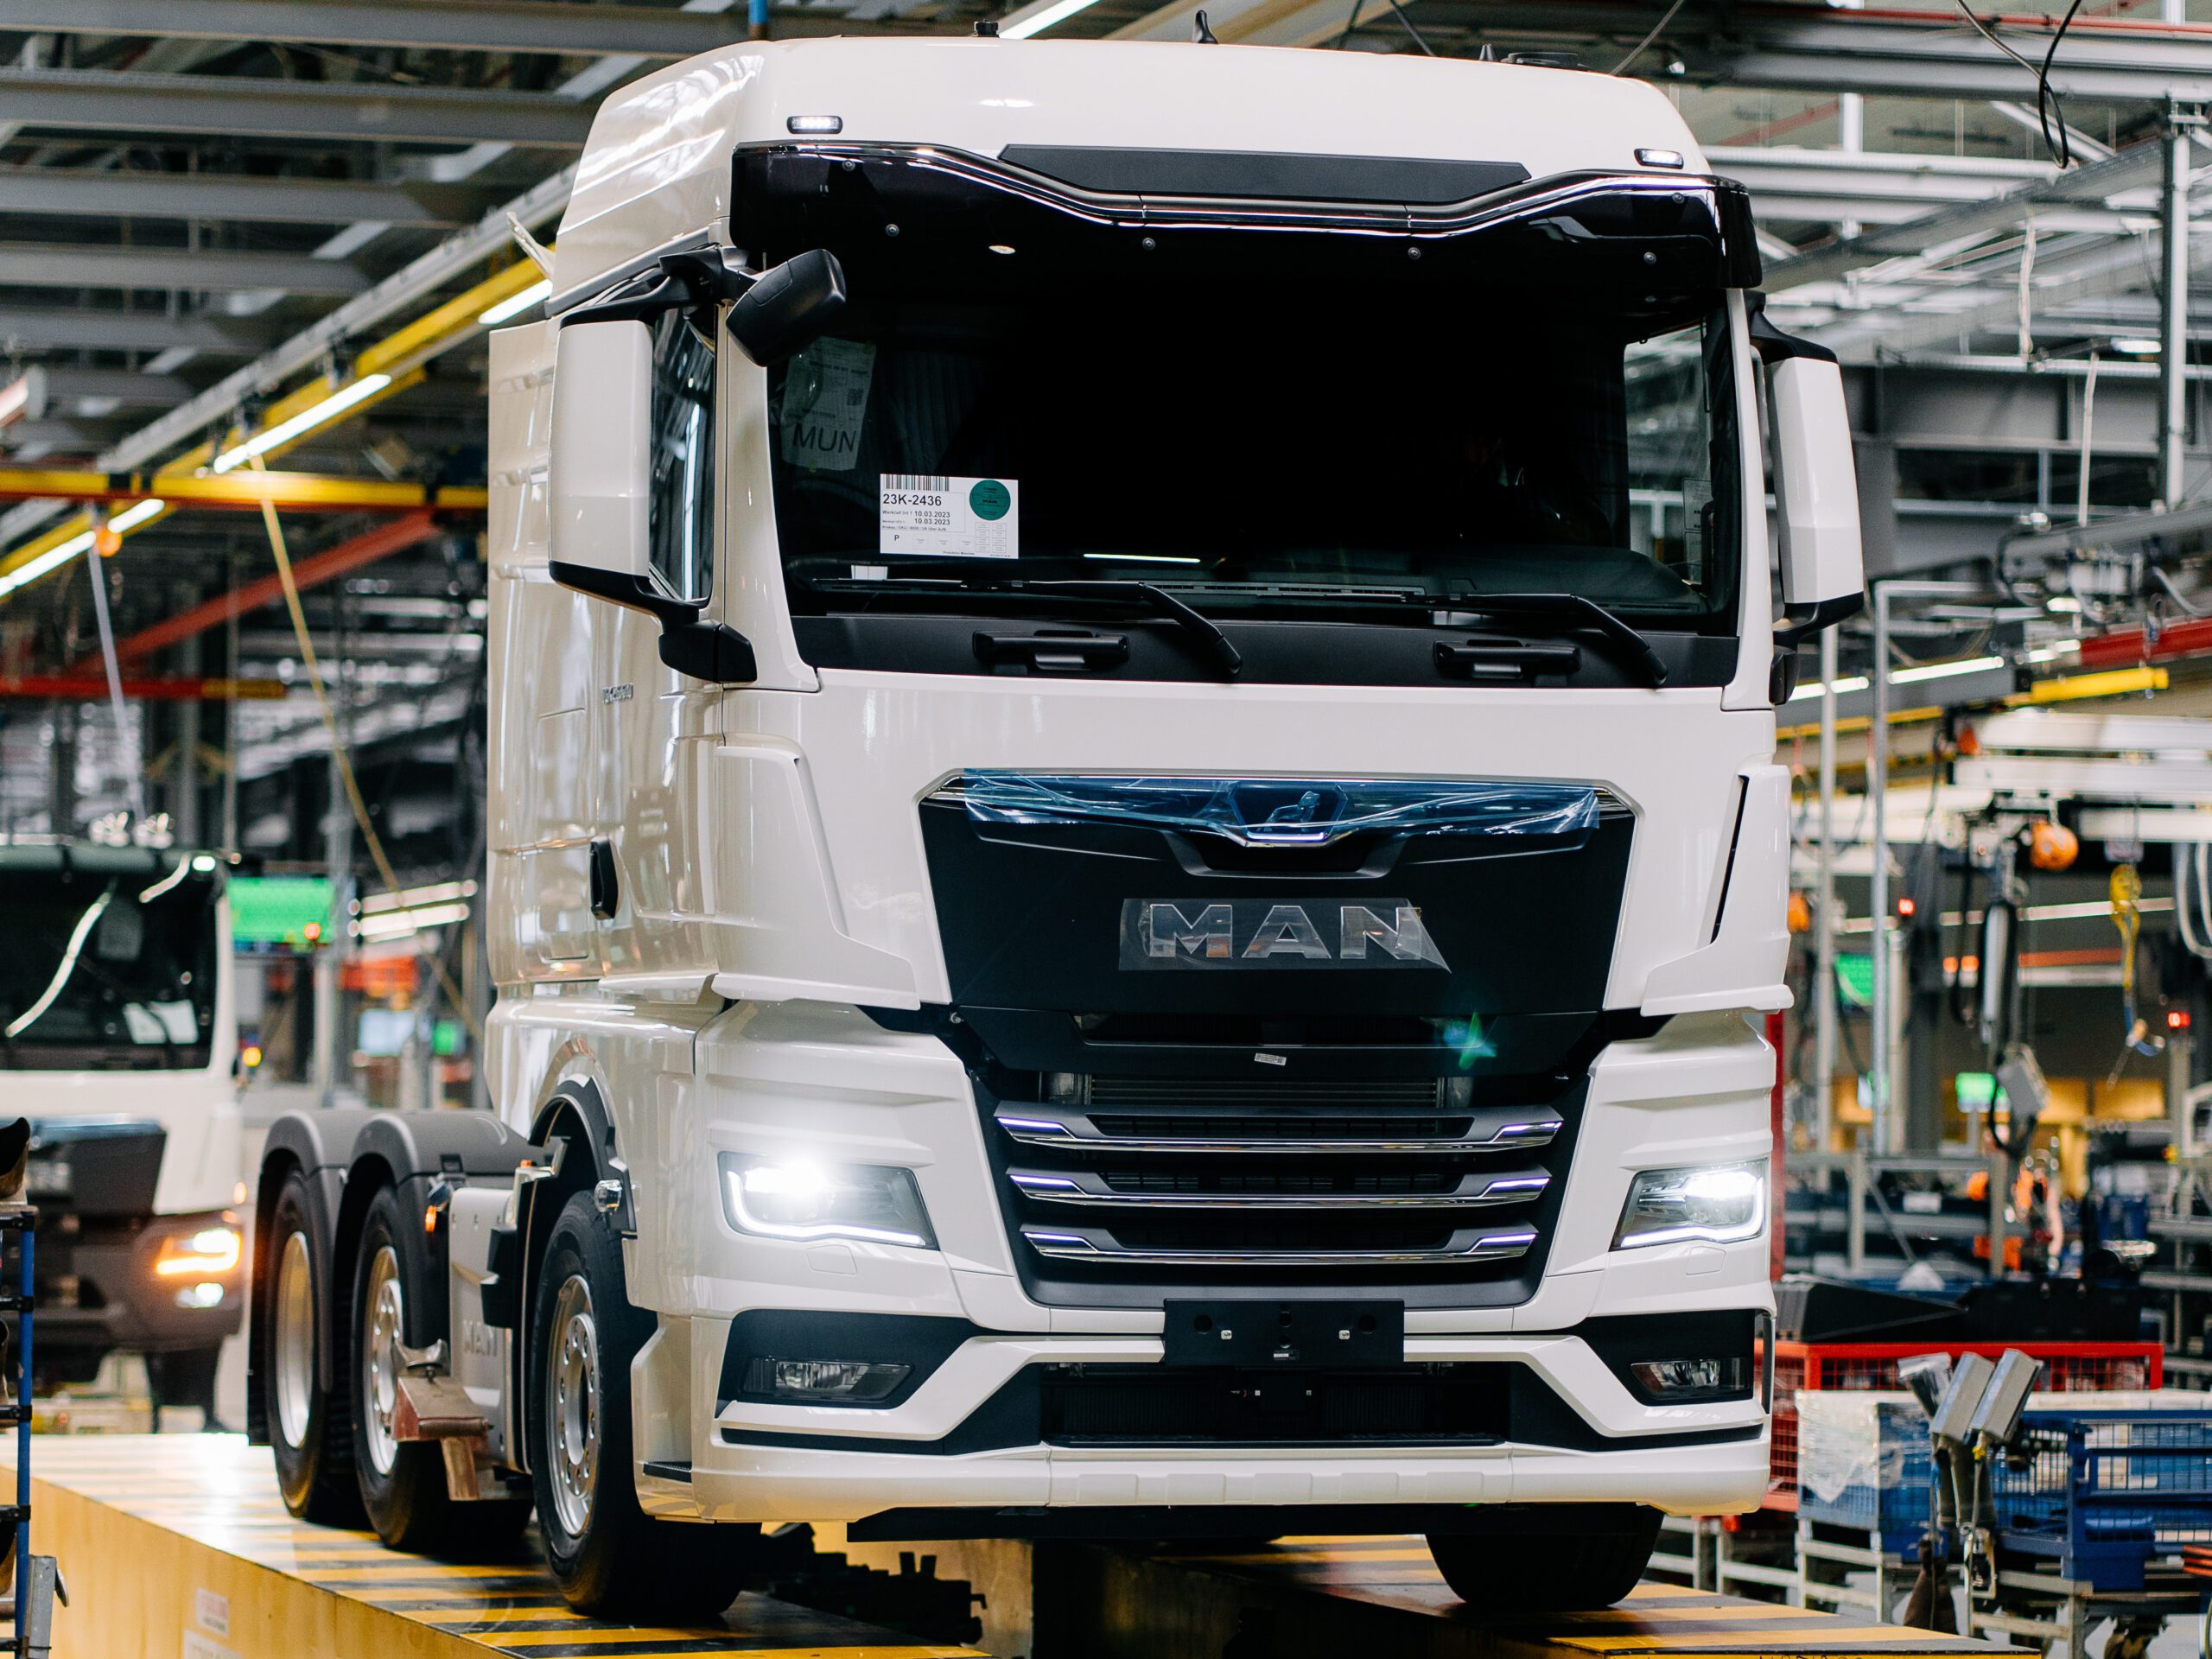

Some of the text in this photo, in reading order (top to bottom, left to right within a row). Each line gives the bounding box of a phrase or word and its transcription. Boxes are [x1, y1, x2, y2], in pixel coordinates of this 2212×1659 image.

[792, 423, 857, 454] MUN
[882, 493, 942, 506] 23K-2436
[1149, 904, 1421, 960] MAN
